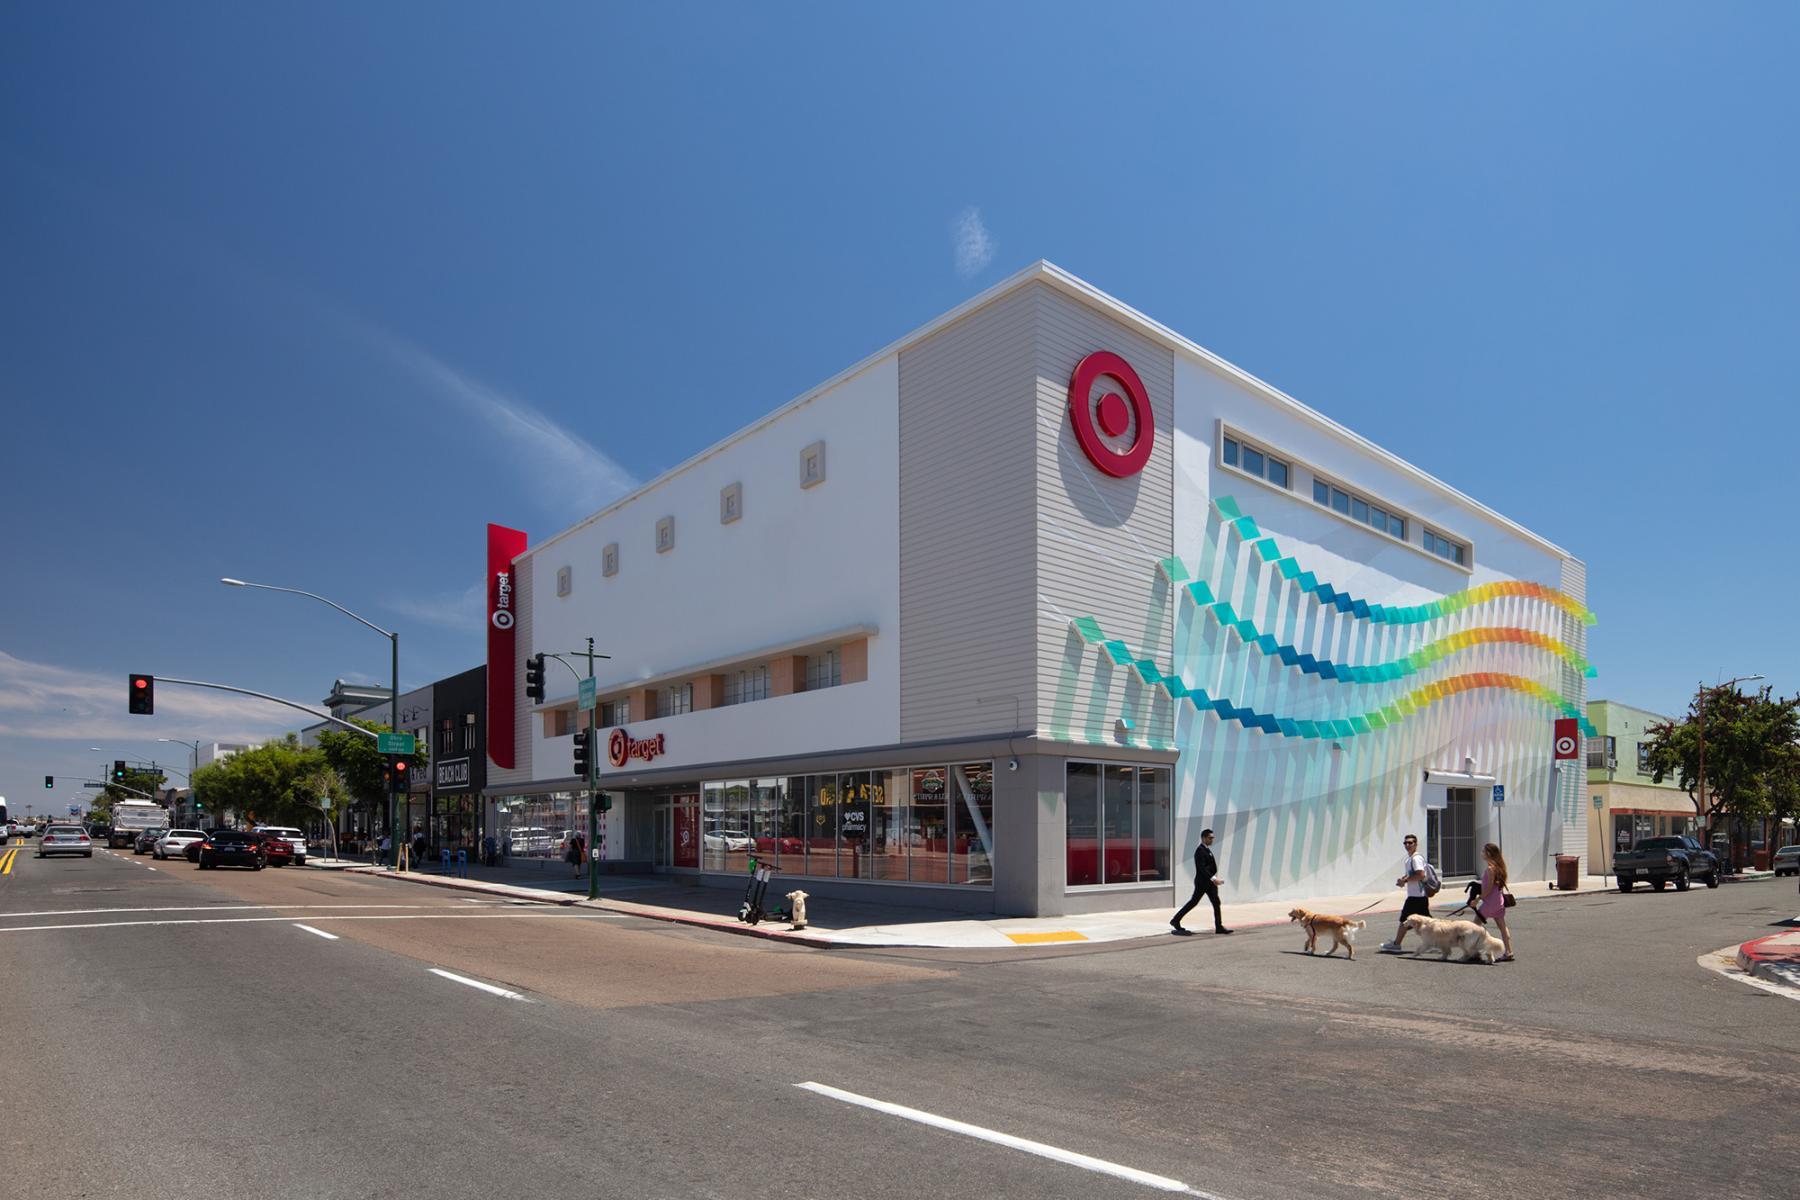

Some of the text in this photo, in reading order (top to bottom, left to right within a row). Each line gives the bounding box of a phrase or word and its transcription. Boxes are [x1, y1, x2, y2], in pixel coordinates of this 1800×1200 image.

[497, 571, 511, 608] target
[627, 733, 665, 761] target
[439, 763, 468, 784] BEACH CLUB
[850, 811, 864, 821] CVS
